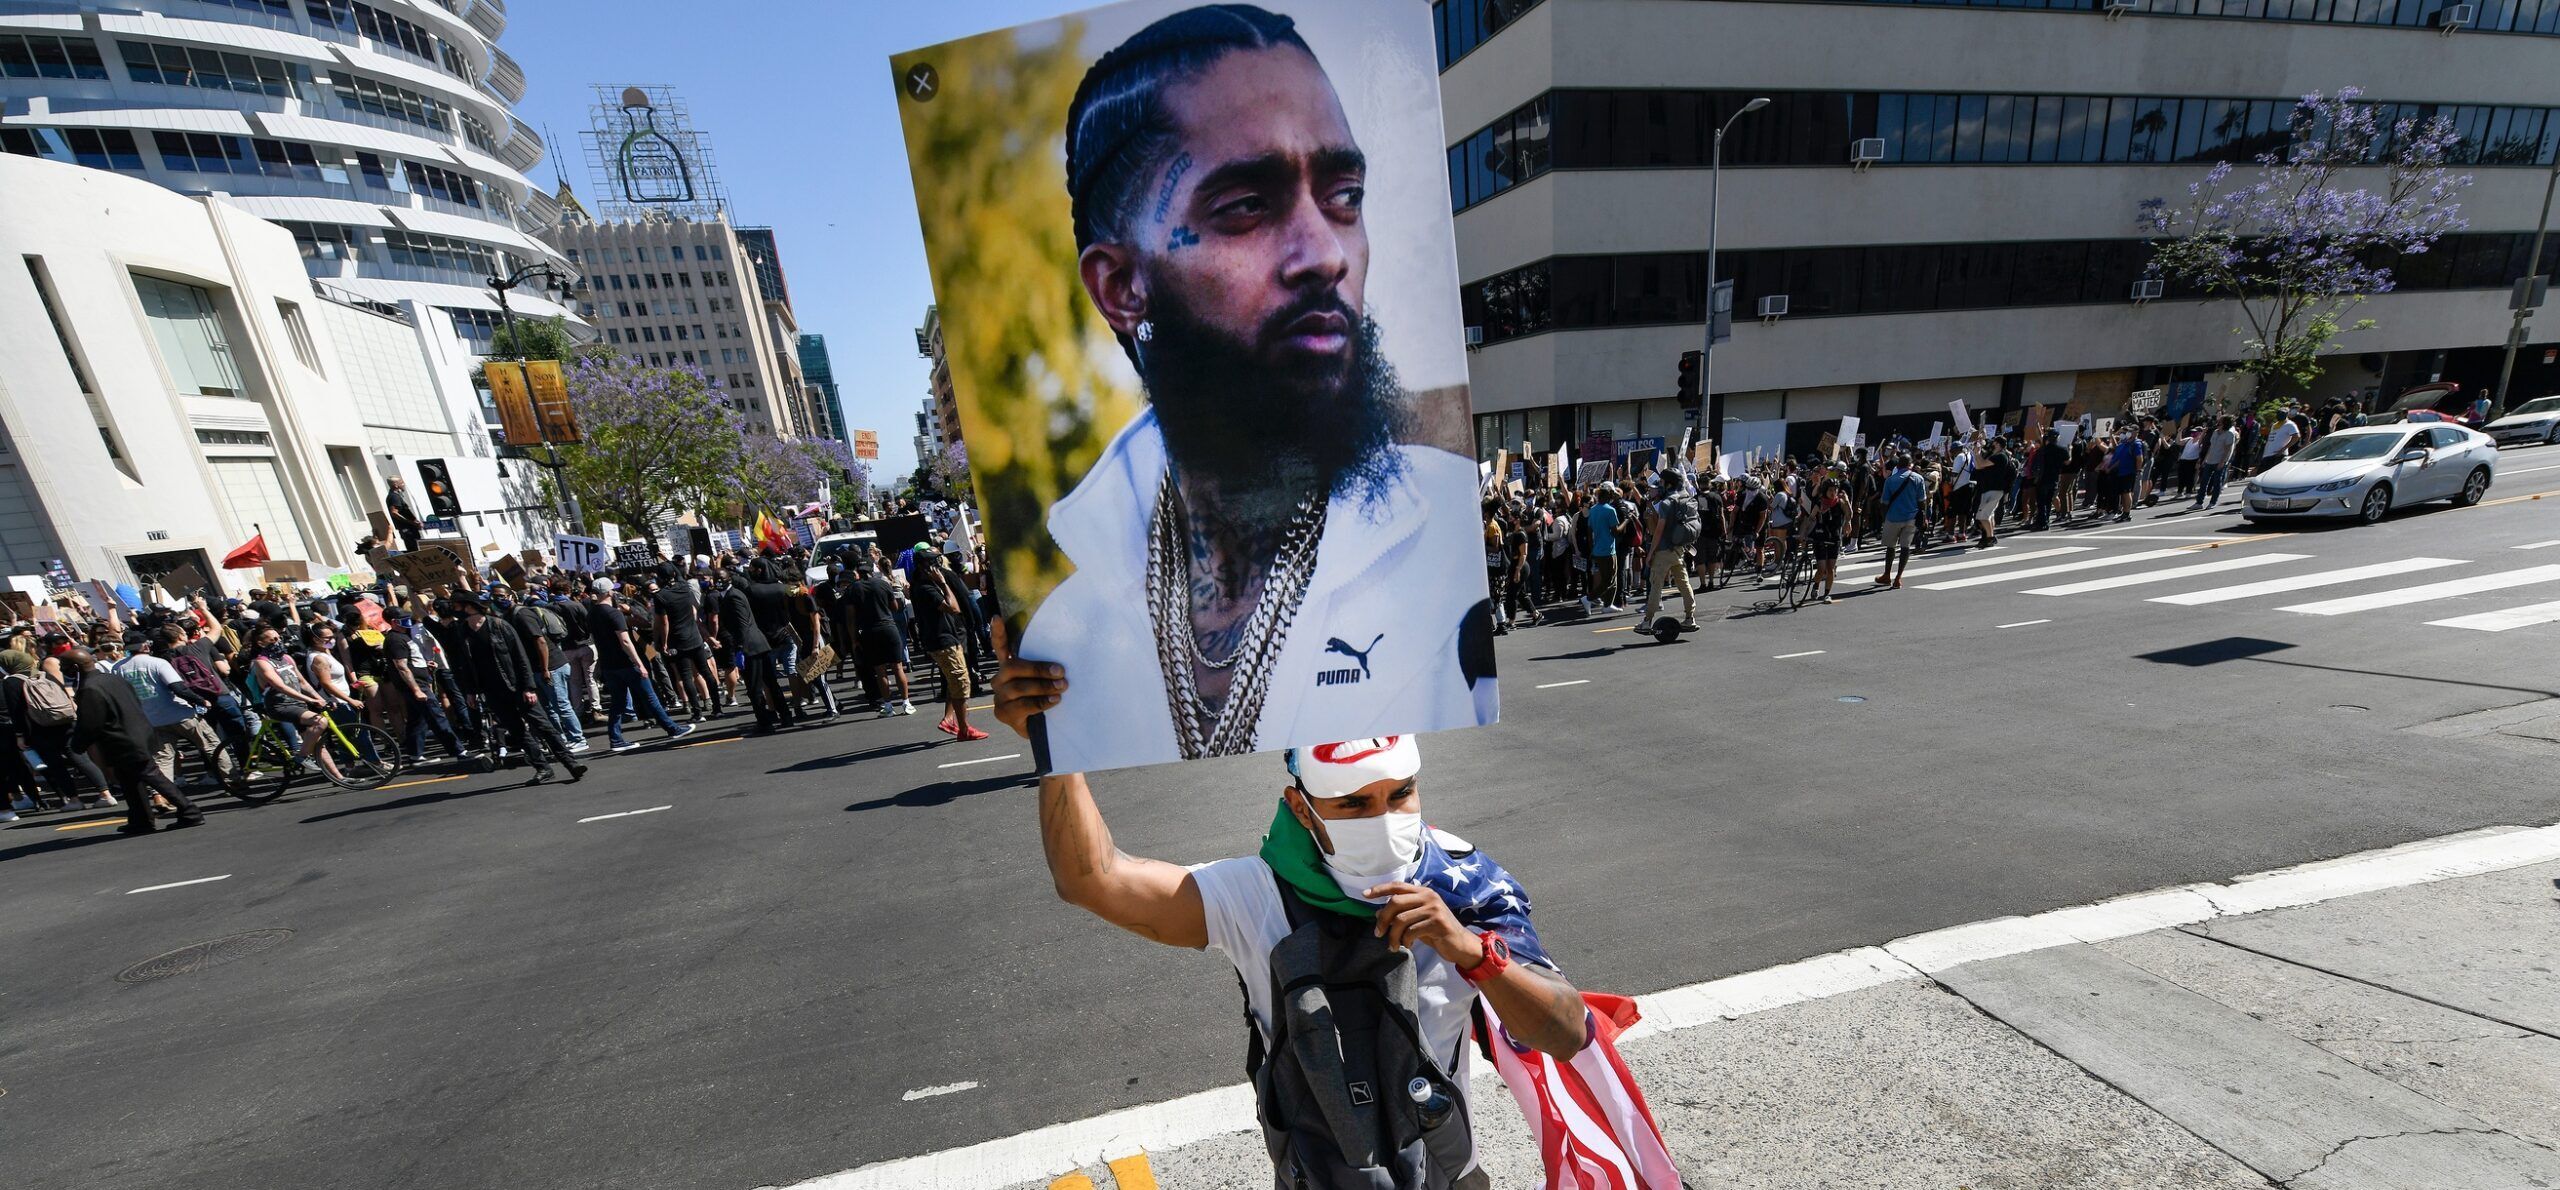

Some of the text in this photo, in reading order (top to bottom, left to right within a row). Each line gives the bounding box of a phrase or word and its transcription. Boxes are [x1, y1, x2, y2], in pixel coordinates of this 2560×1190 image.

[2132, 397, 2159, 408] MATTER
[147, 530, 169, 541] 1770
[559, 539, 600, 566] FTP
[618, 544, 650, 553] BLACK
[620, 552, 651, 561] LIVES
[1316, 668, 1361, 687] PUMA
